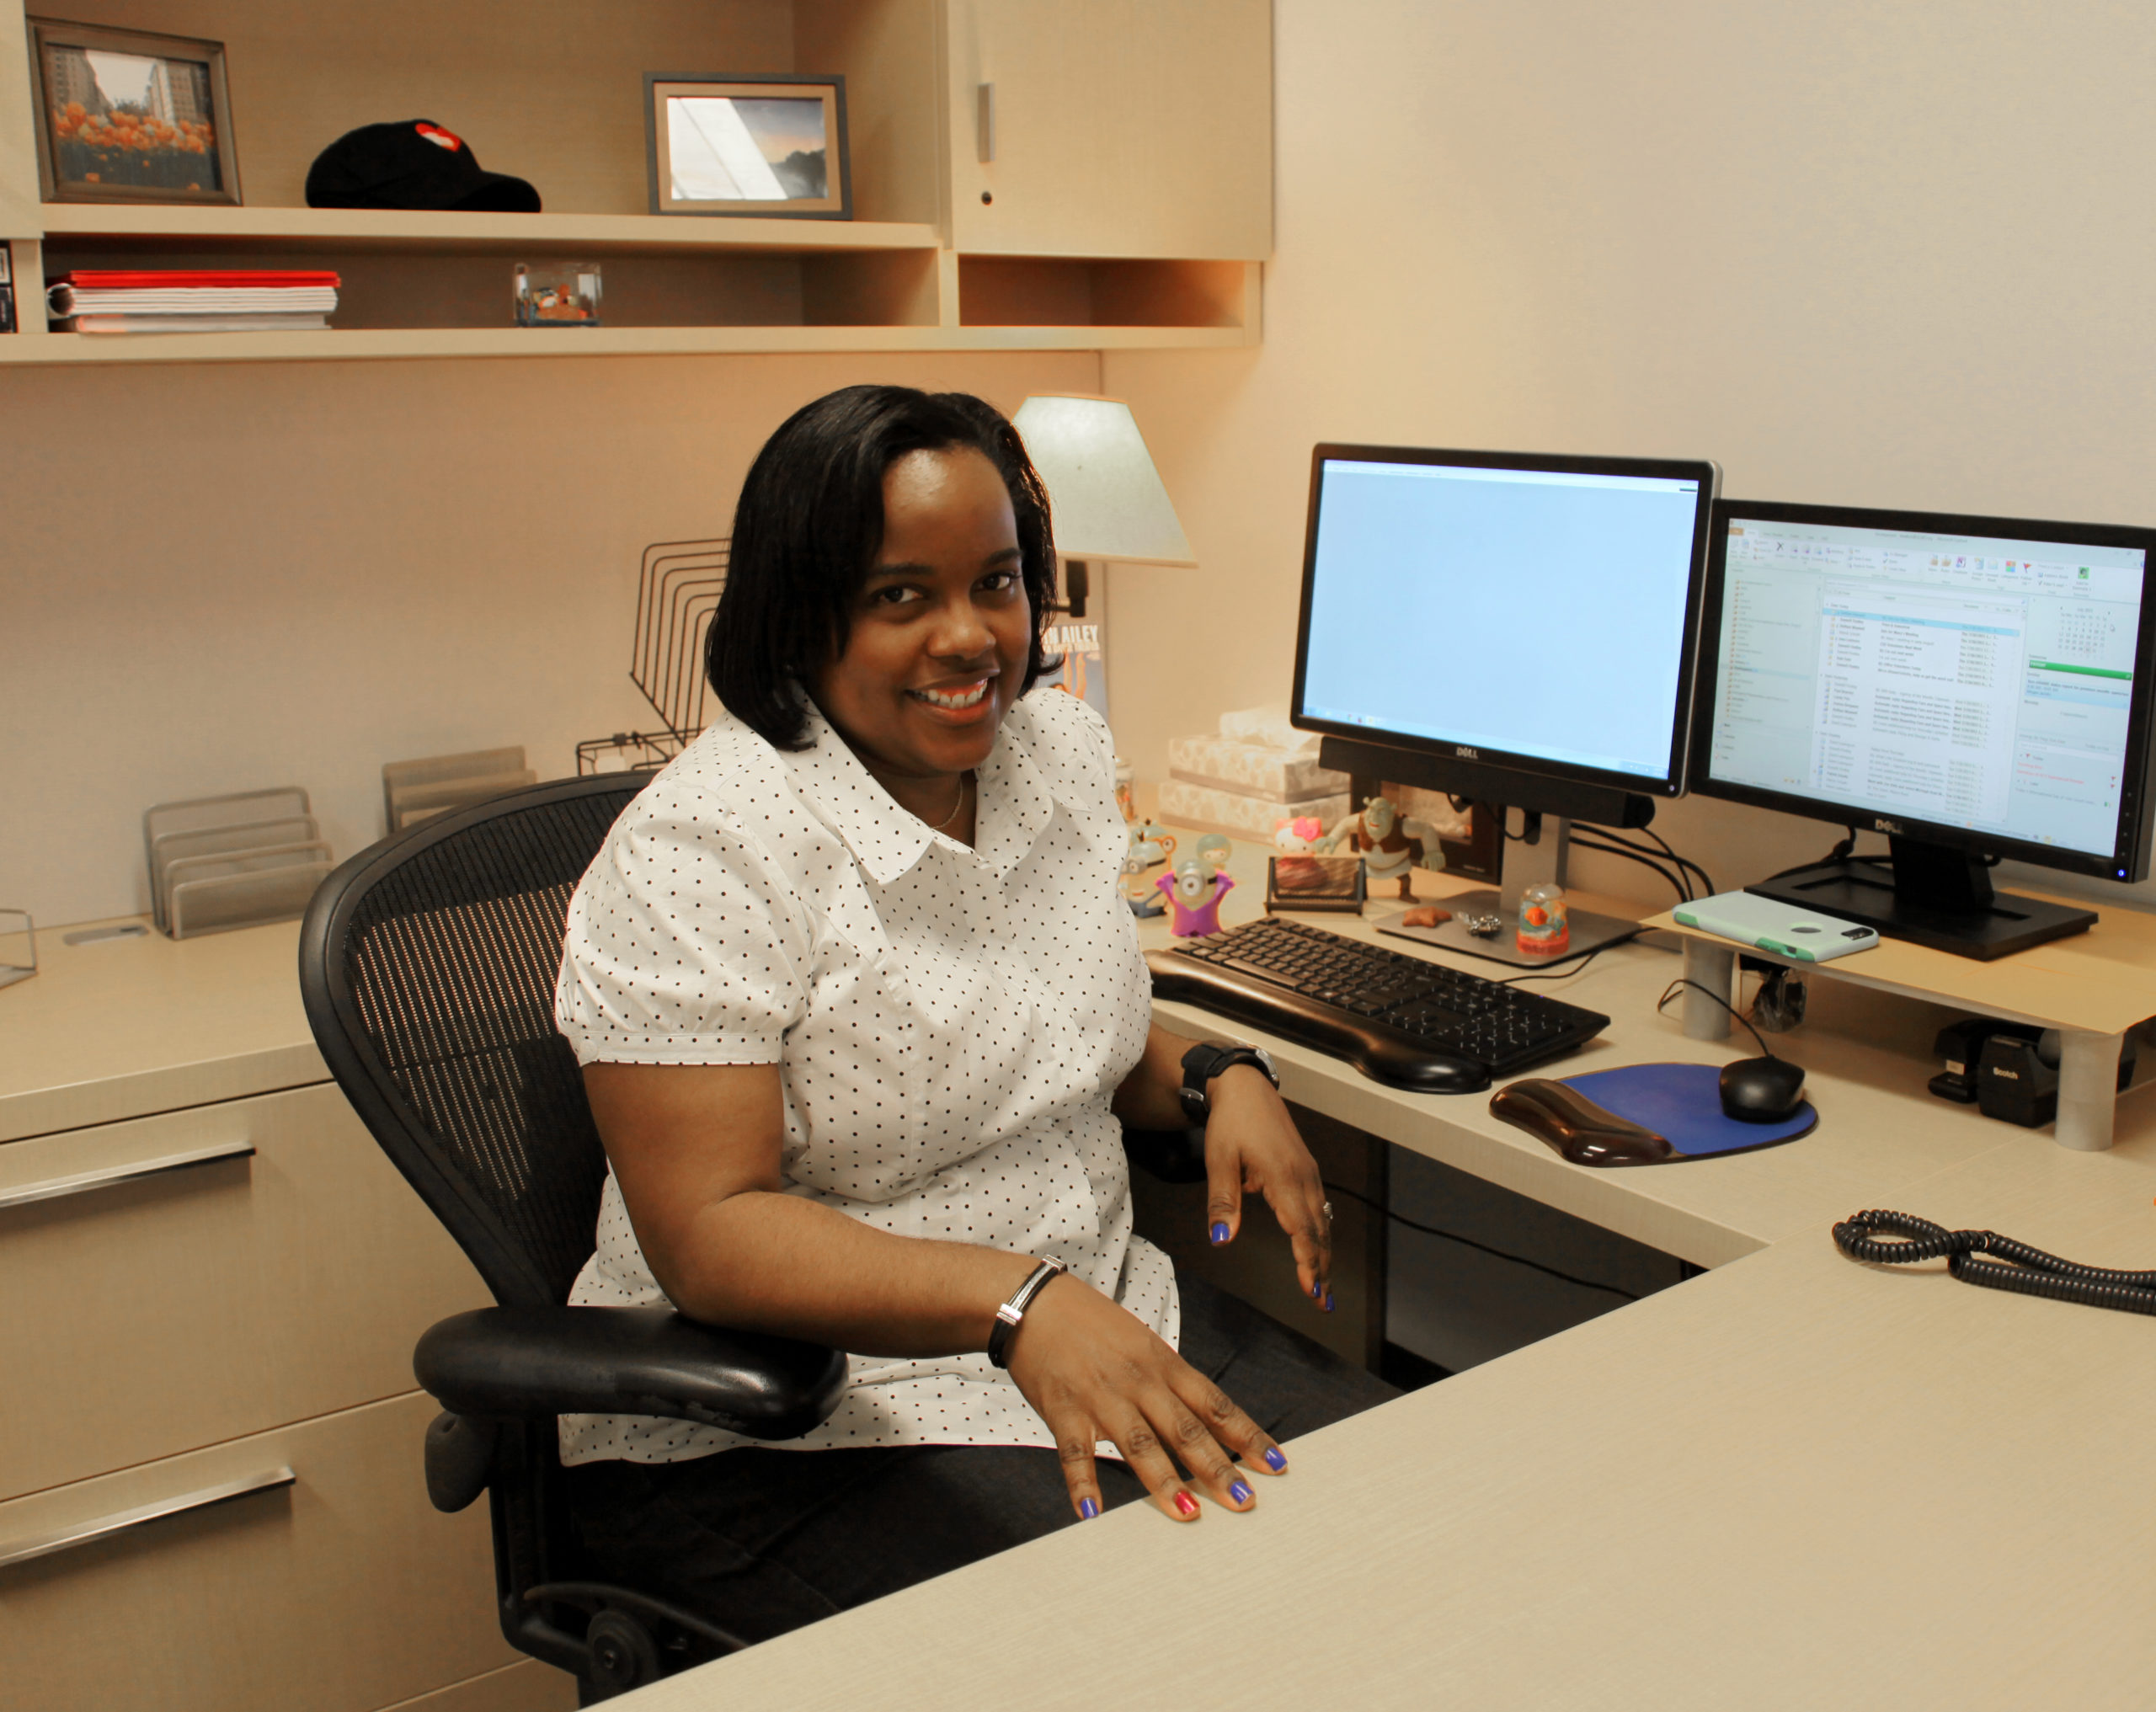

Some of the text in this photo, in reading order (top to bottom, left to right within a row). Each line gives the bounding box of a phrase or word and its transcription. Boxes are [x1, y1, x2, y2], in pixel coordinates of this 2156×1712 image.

[1061, 624, 1098, 643] AILEY
[1456, 746, 1479, 760] DELL
[1875, 819, 1904, 835] DELL
[1993, 1064, 2018, 1080] Scotch
